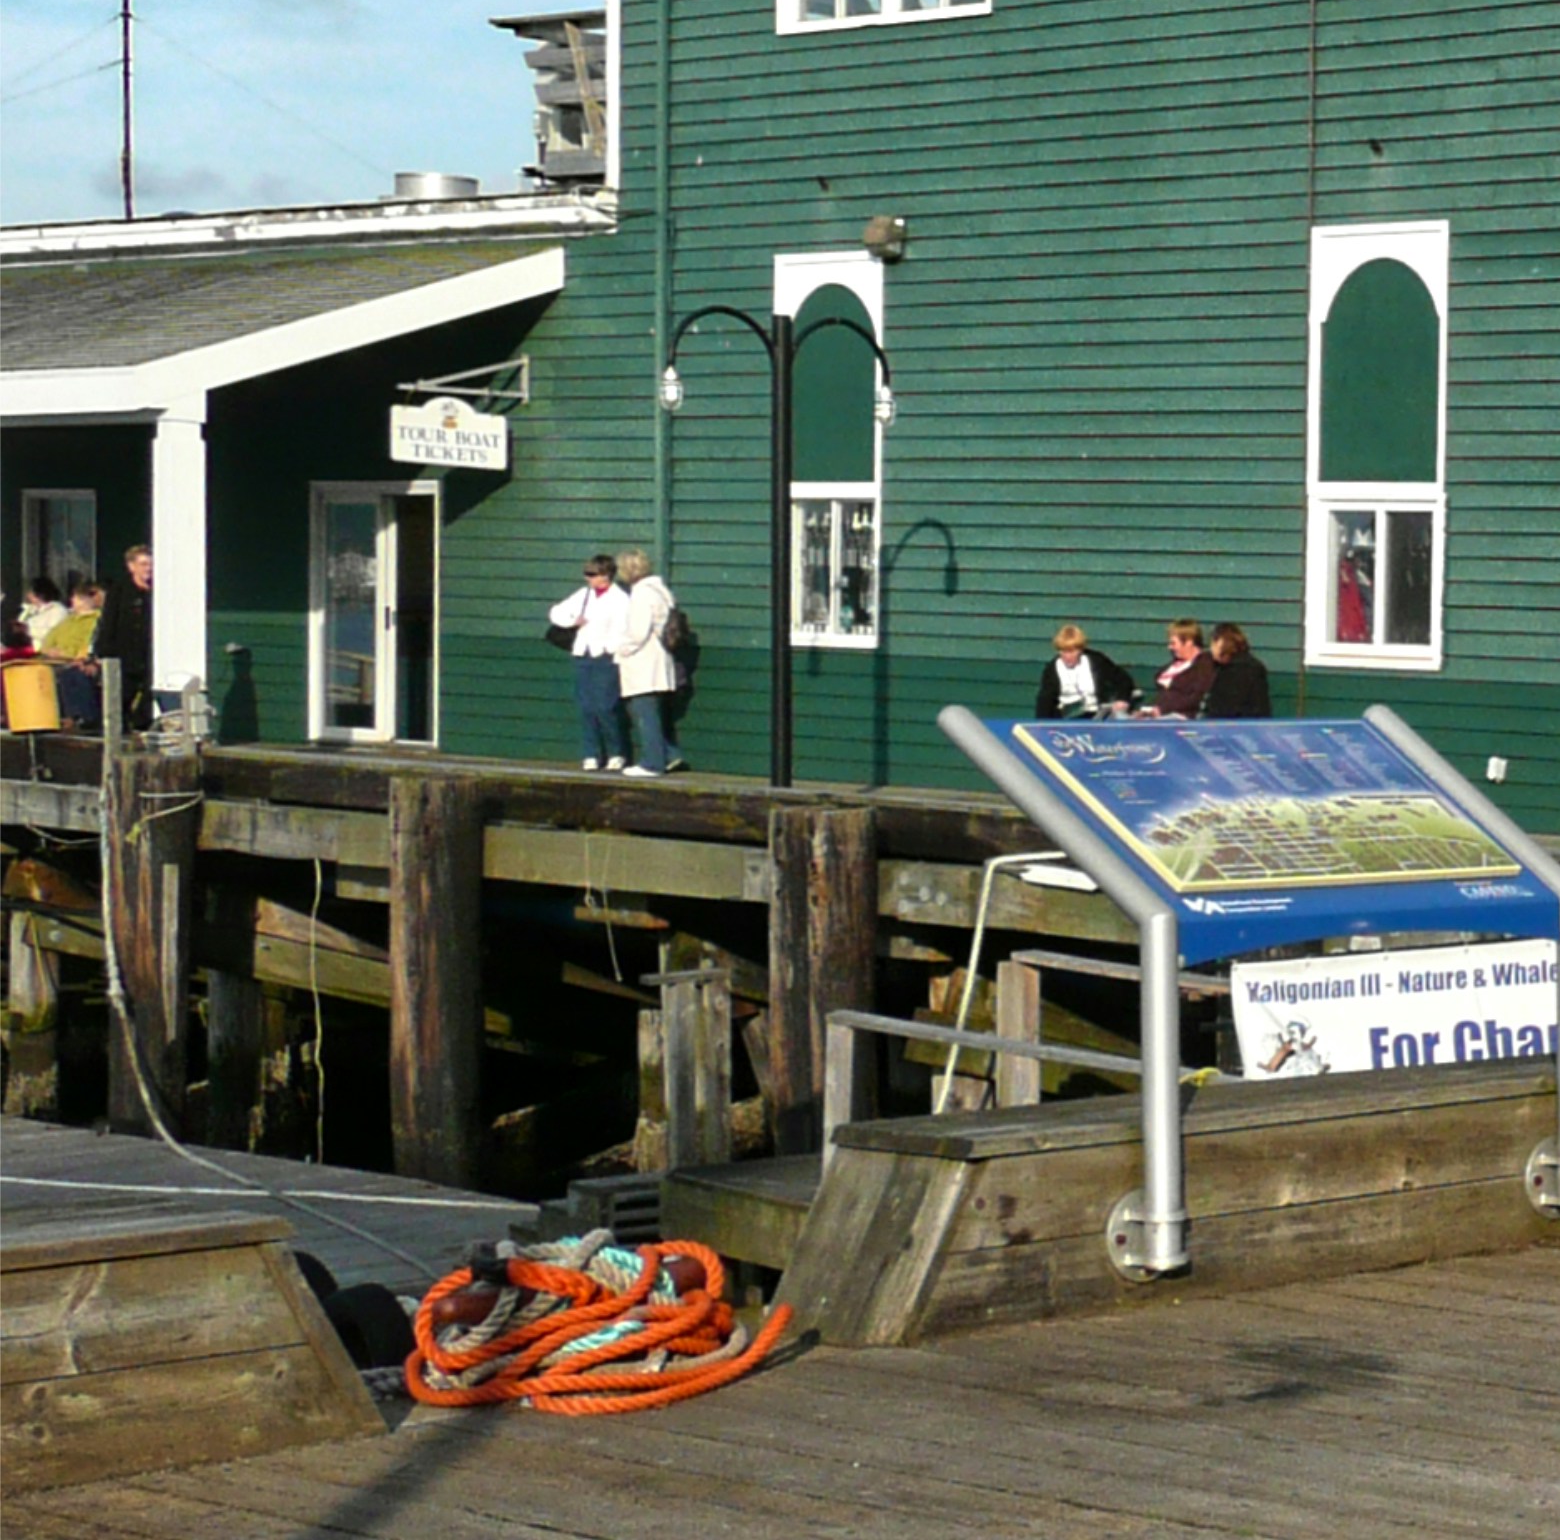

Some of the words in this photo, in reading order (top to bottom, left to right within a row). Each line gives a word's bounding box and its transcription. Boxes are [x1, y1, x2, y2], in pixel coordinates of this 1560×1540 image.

[397, 424, 447, 443] TOUR
[455, 430, 503, 448] BOAT
[411, 443, 489, 463] TICKETS
[1398, 967, 1468, 995] Nature
[1473, 968, 1487, 988] &
[1491, 959, 1558, 987] Whale
[1368, 1026, 1440, 1070] For
